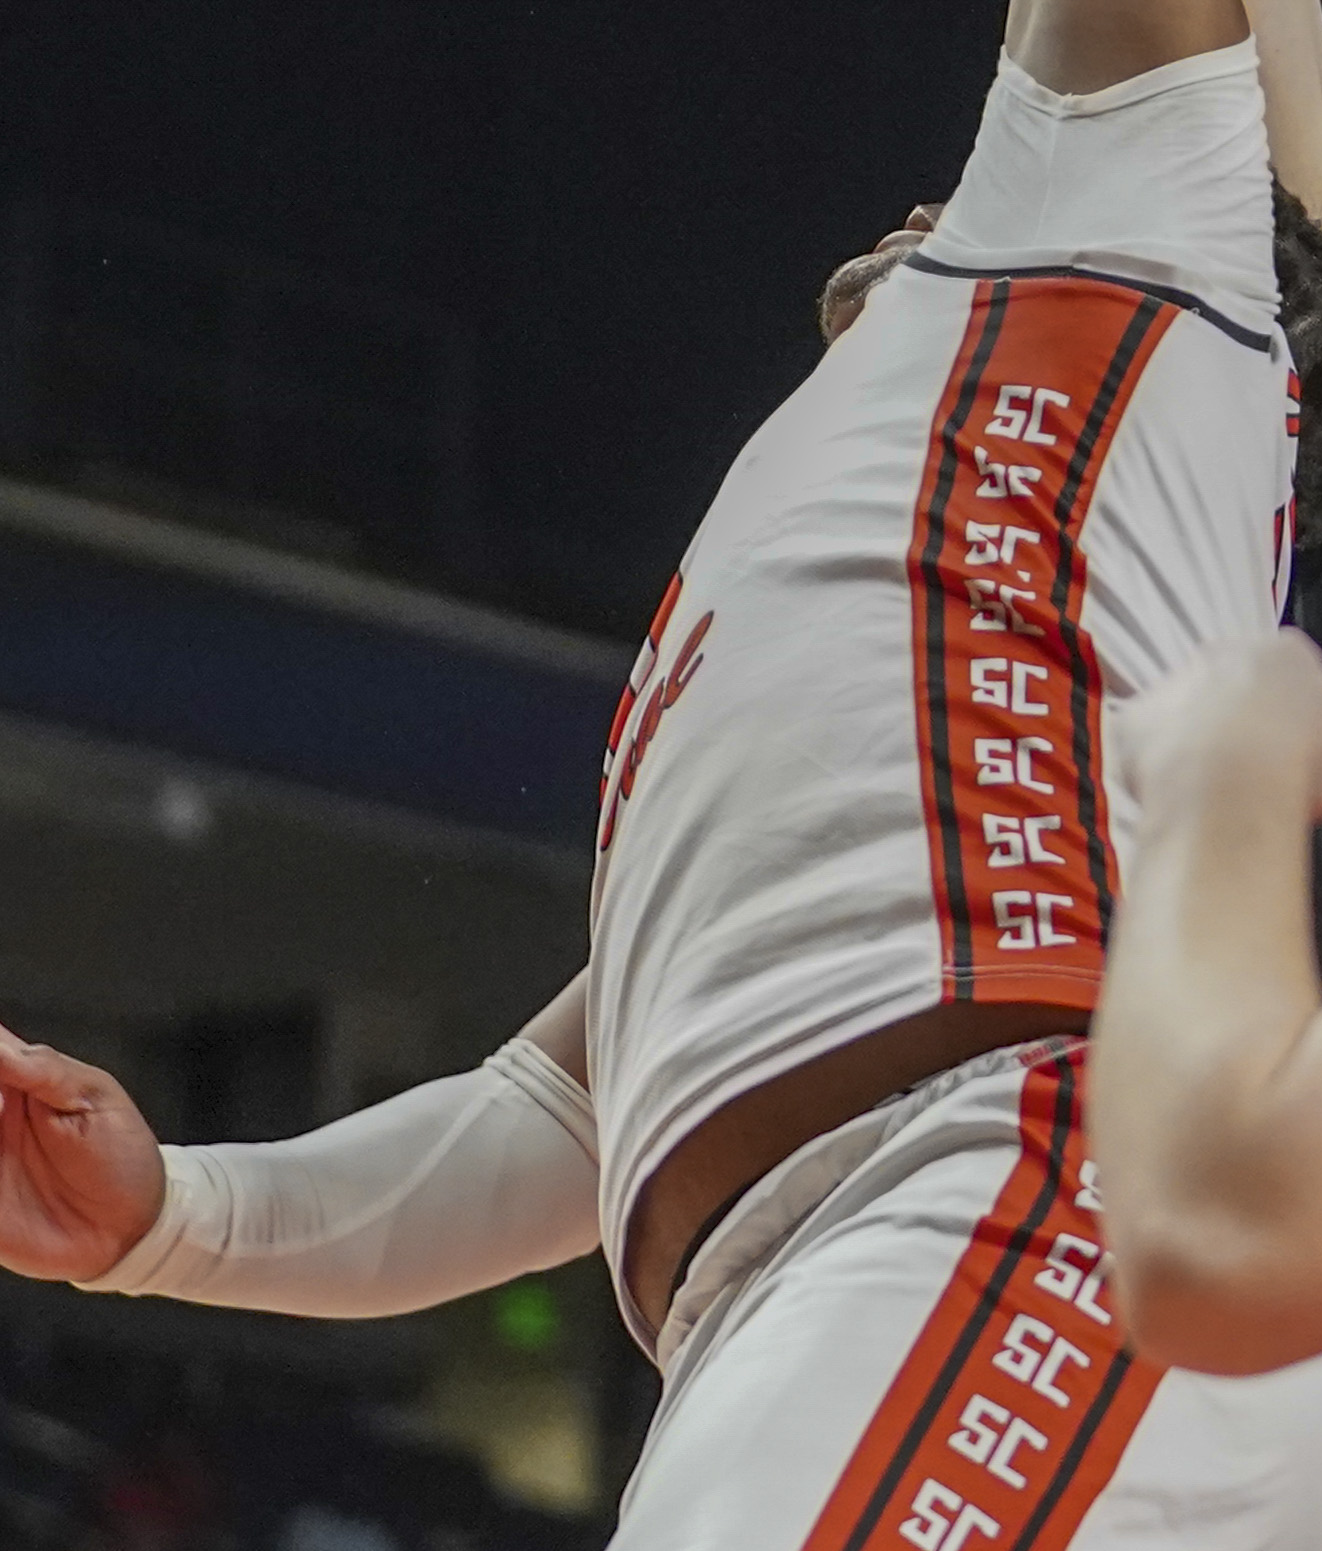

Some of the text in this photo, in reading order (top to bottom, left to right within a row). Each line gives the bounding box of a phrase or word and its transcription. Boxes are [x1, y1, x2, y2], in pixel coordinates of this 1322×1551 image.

[984, 384, 1070, 446] SC
[970, 657, 1049, 716] SC
[974, 736, 1054, 794] SC
[981, 813, 1067, 868] SC
[992, 890, 1077, 950] SC
[991, 1312, 1091, 1409] SC
[948, 1393, 1049, 1490] SC
